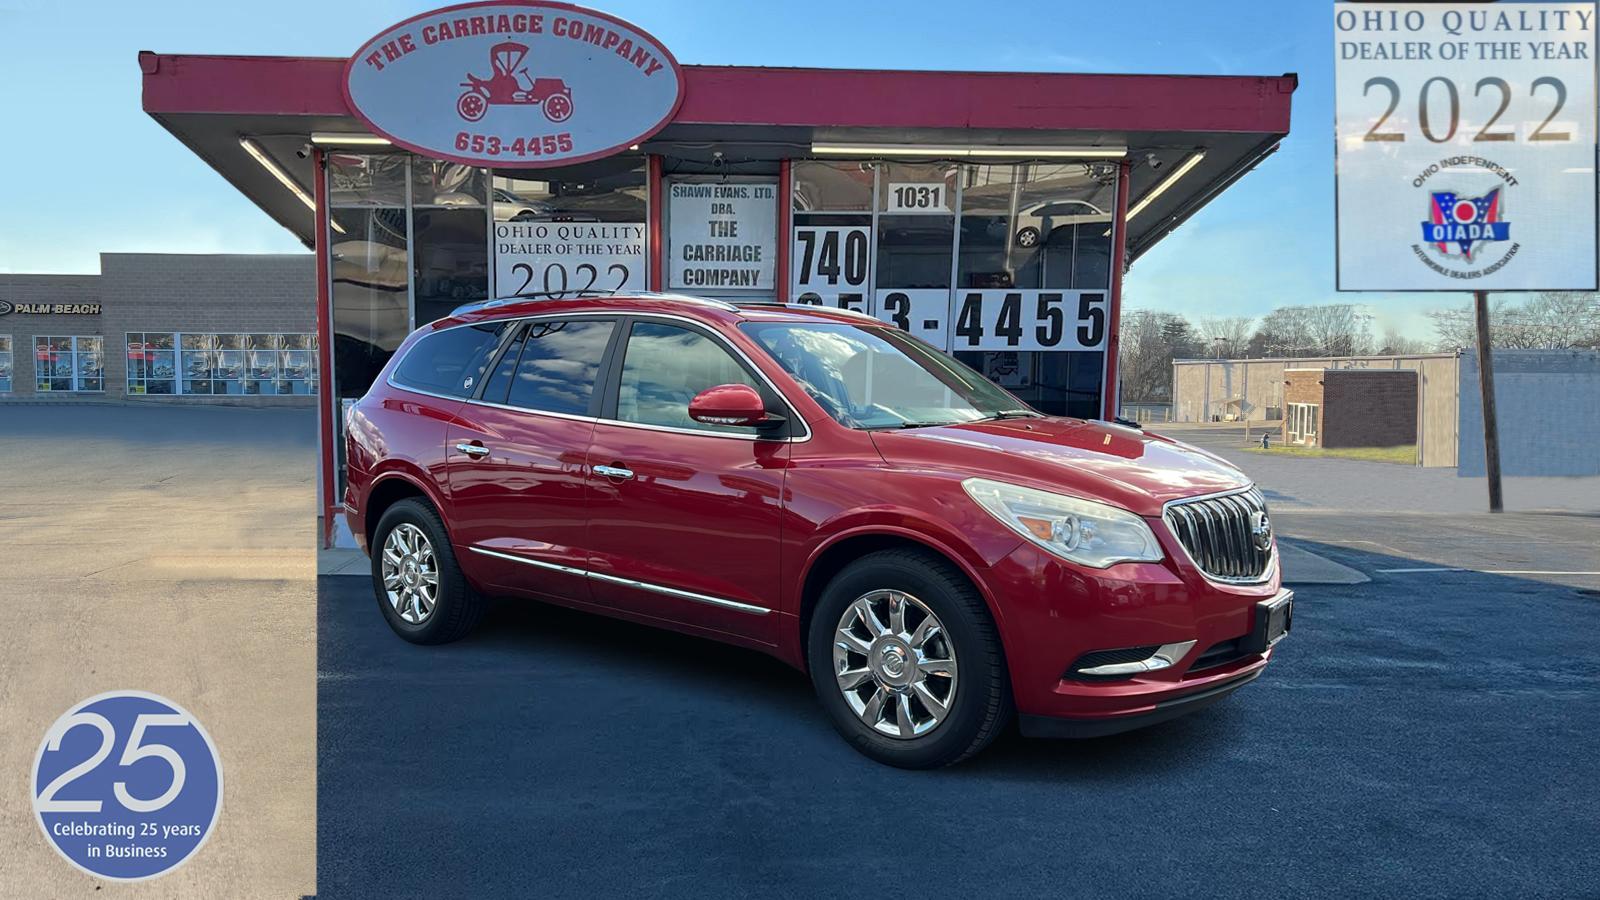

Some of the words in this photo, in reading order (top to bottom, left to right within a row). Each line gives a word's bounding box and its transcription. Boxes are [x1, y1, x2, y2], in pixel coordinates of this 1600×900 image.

[1336, 10, 1425, 31] OHIO
[1442, 10, 1592, 35] QUALITY
[366, 34, 416, 71] THE
[422, 14, 543, 45] CARRIAGE
[552, 17, 663, 77] COMPANY
[1340, 41, 1433, 60] DEALER
[1439, 41, 1469, 60] OF
[1475, 41, 1522, 59] THE
[1528, 41, 1589, 59] YEAR
[1362, 76, 1571, 143] 2022
[455, 132, 573, 156] 653-4455
[1412, 163, 1440, 188] OHIO
[1439, 155, 1519, 188] INDEPENDENT
[672, 186, 712, 199] SHAWN
[754, 187, 774, 199] LTD.
[895, 187, 940, 208] 1031
[497, 226, 549, 238] OHIO
[558, 226, 644, 241] QUALITY
[708, 220, 738, 238] THE
[1432, 224, 1495, 240] OIADA
[499, 243, 552, 255] DEALER
[555, 243, 573, 255] OF
[576, 243, 603, 255] THE
[606, 243, 641, 255] YEAR
[683, 244, 762, 263] CARRIAGE
[797, 230, 868, 286] 740
[511, 263, 629, 299] 2022
[683, 268, 760, 286] COMPANY
[1449, 269, 1482, 279] DEALERS
[14, 303, 51, 314] PALM
[54, 303, 101, 314] BEACH
[797, 292, 1105, 347] 3-4455
